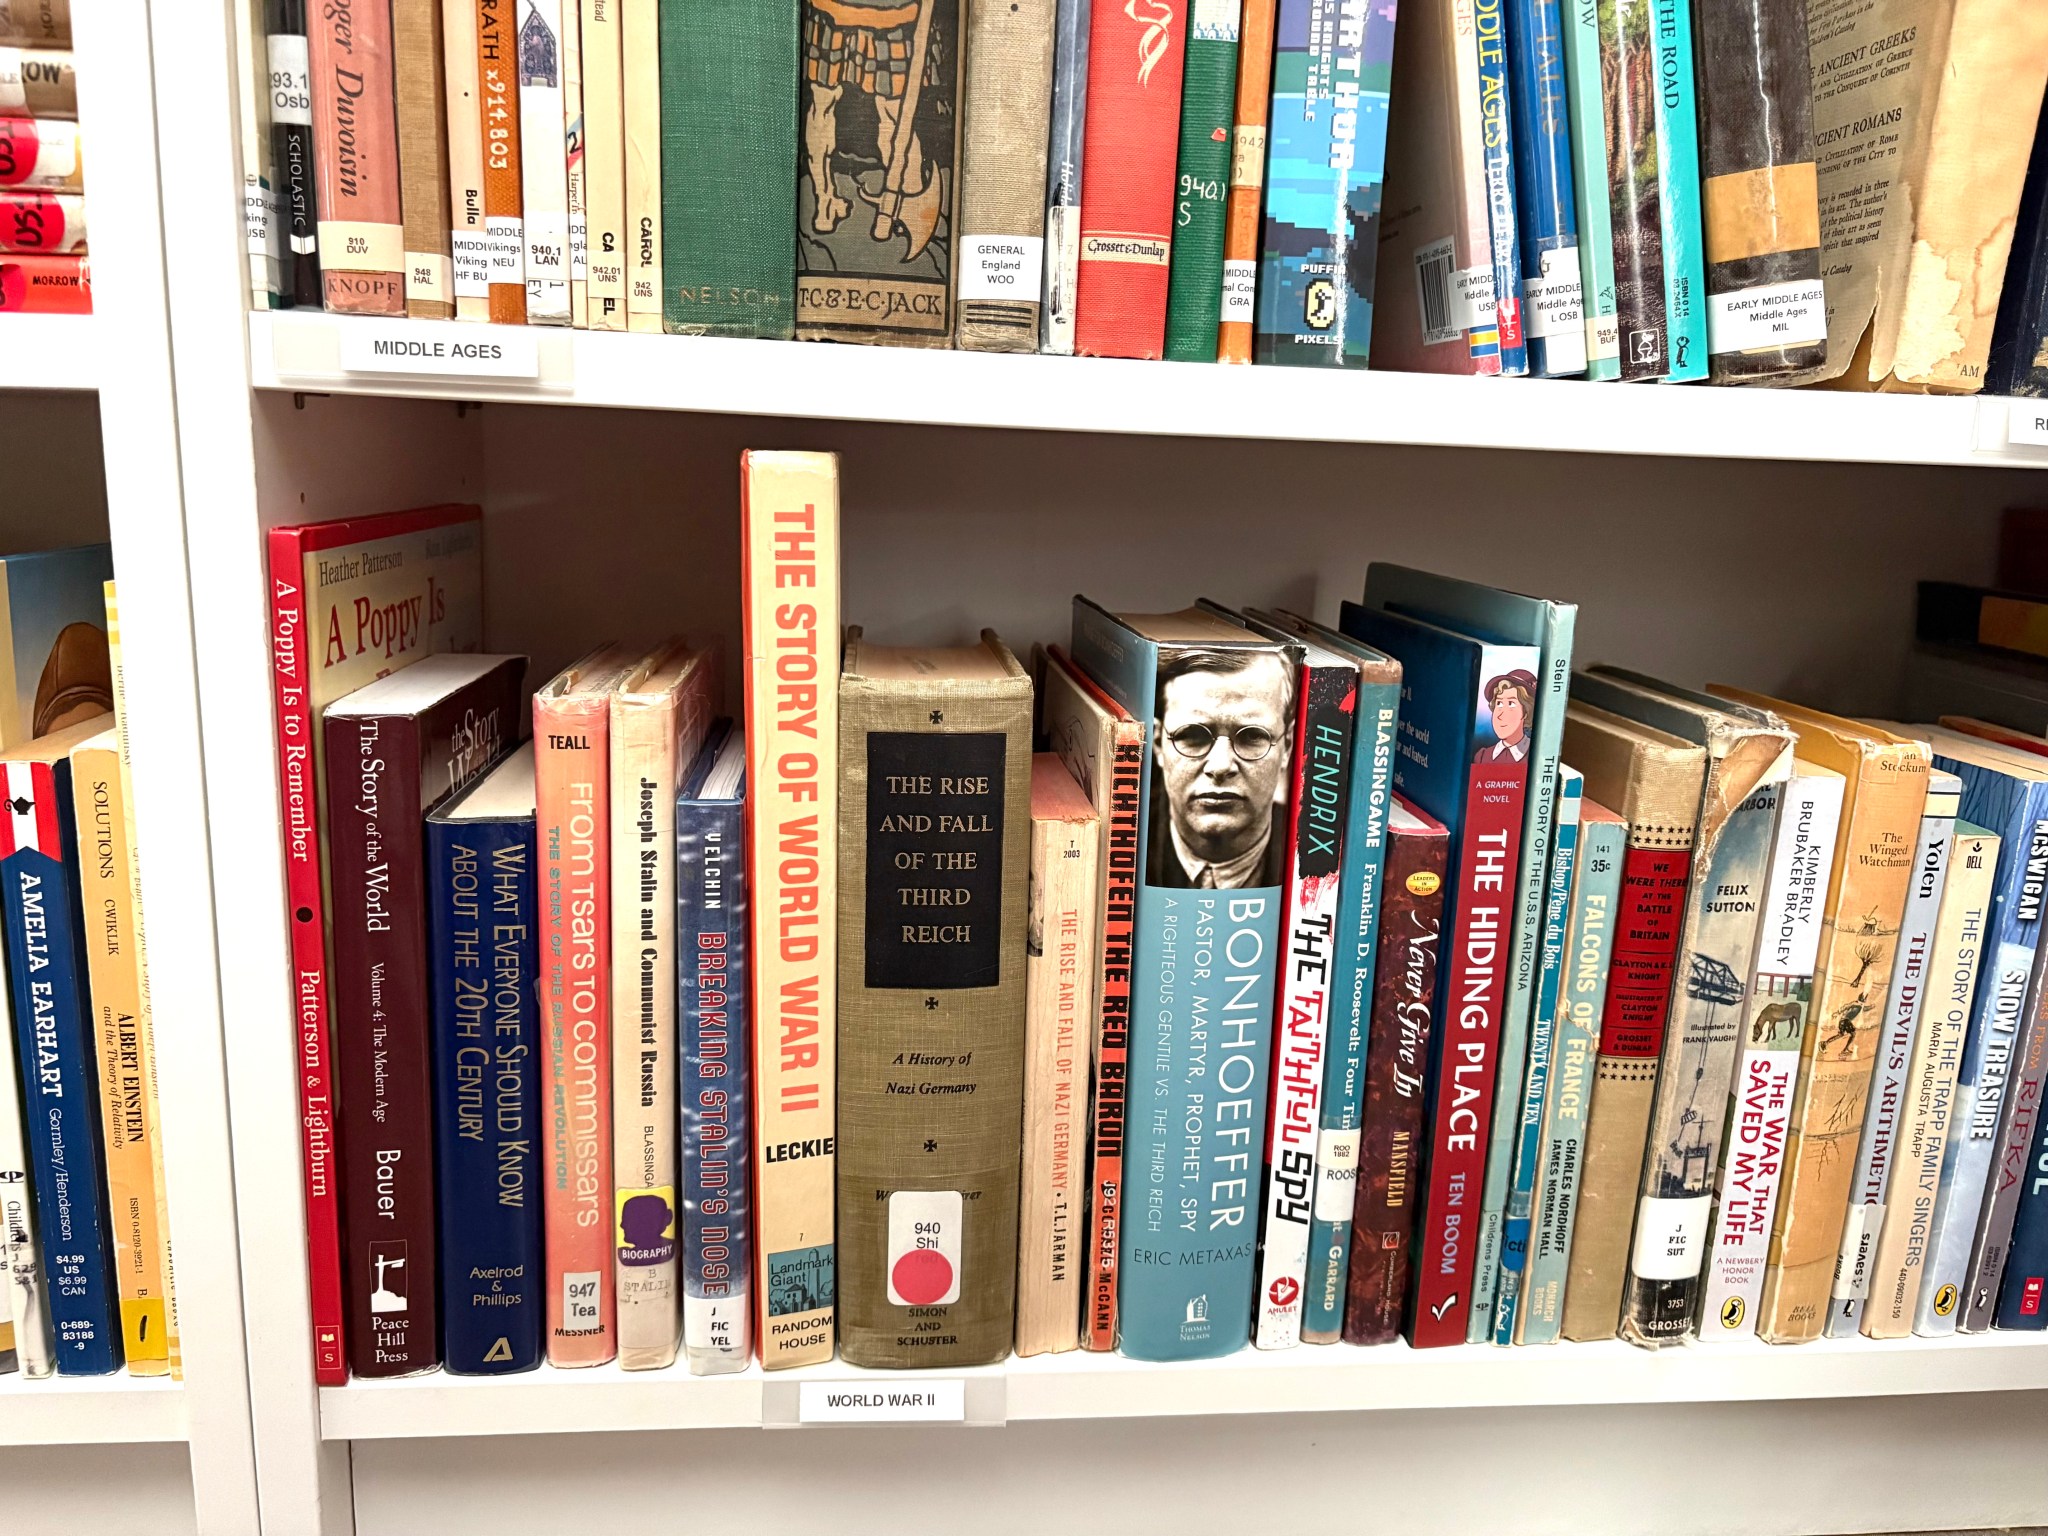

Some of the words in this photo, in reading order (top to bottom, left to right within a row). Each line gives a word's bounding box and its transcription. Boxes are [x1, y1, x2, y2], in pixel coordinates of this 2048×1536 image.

[1818, 48, 1865, 77] ANCIENT
[1869, 27, 1916, 56] GREEKS
[1662, 44, 1680, 110] ROAD
[275, 92, 310, 109] Osb
[335, 64, 367, 198] Duvoisin
[486, 69, 508, 170] x914.803
[288, 134, 306, 226] SCHOLASTIC
[465, 189, 478, 225] Bulla
[347, 245, 368, 254] DUV
[348, 237, 365, 246] 910
[531, 245, 562, 256] 940.1
[977, 245, 1025, 256] GENERAL
[414, 268, 431, 276] 948
[535, 255, 559, 266] LAN
[593, 266, 621, 275] 942.01
[598, 274, 618, 283] UNS
[981, 260, 1021, 271] England
[328, 278, 398, 300] KNOPF
[413, 276, 433, 285] HAL
[633, 288, 653, 298] UNS
[635, 281, 651, 290] 942
[987, 275, 1014, 285] WOO
[1727, 299, 1758, 312] EARLY
[1762, 295, 1799, 307] MIDDLE
[1801, 290, 1823, 302] AGES
[1750, 309, 1786, 322] Middle
[1788, 306, 1808, 319] Ages
[1772, 322, 1789, 333] MIL
[373, 340, 445, 358] MIDDLE
[450, 342, 502, 360] AGES
[774, 503, 816, 589] THE
[319, 557, 360, 588] Heather
[362, 548, 403, 579] Patterson
[276, 580, 297, 599] A
[274, 608, 299, 679] Poppy
[775, 603, 818, 740] STORY
[1553, 658, 1566, 693] Stein
[282, 685, 302, 706] Is
[284, 709, 299, 736] to
[359, 720, 379, 754] The
[548, 735, 590, 750] TEALL
[355, 758, 385, 819] Story
[777, 752, 819, 803] OF
[886, 777, 933, 795] THE
[940, 777, 990, 795] RISE
[1307, 724, 1342, 856] HENDRIX
[1365, 708, 1394, 848] BLASSINGAME
[286, 742, 312, 862] Remember
[637, 777, 657, 842] Joseph
[366, 822, 381, 838] of
[880, 814, 932, 833] AND
[939, 814, 994, 833] FALL
[1882, 832, 1902, 843] The
[366, 839, 378, 862] the
[894, 852, 926, 870] OF
[932, 852, 978, 870] THE
[1474, 829, 1507, 892] THE
[1789, 801, 1814, 887] BRUBAKER
[1859, 855, 1910, 867] Watchman
[1870, 844, 1908, 856] Winged
[1966, 856, 1982, 868] DELL
[93, 781, 114, 878] SOLUTIONS
[105, 899, 119, 956] CWIKLIK
[452, 843, 478, 920] ABOUT
[492, 843, 526, 916] WHAT
[641, 850, 657, 903] Stalin
[705, 833, 721, 910] YELCHIN
[1797, 845, 1821, 924] KIMBERLY
[1919, 838, 1944, 899] Yolen
[365, 863, 390, 932] World
[778, 814, 819, 963] WORLD
[897, 888, 971, 906] THIRD
[1717, 884, 1749, 896] FELIX
[20, 871, 49, 973] AMELIA
[641, 908, 657, 941] and
[1706, 901, 1755, 914] SUTTON
[902, 925, 971, 943] REICH
[1190, 899, 1215, 986] PASTOR,
[1575, 895, 1607, 993] FALCONS
[1776, 892, 1799, 966] BRADLEY
[454, 931, 479, 968] THE
[1904, 933, 1927, 979] THE
[493, 924, 527, 1037] EVERYONE
[1459, 906, 1500, 1031] HIDING
[455, 978, 489, 1038] 20TH
[641, 948, 657, 1045] Communist
[697, 932, 728, 1078] BREAKING
[1992, 967, 2026, 1033] SNOW
[301, 970, 321, 1069] Patterson
[780, 975, 819, 1072] WAR
[1889, 985, 1917, 1070] DEVIL'S
[32, 981, 62, 1097] EARHART
[118, 1012, 140, 1067] ALBERT
[1185, 995, 1210, 1084] MARTYR,
[306, 1074, 321, 1088] &
[641, 1050, 657, 1107] Russia
[1209, 897, 1266, 1232] BONHOEFFER
[1558, 1038, 1588, 1121] FRANCE
[121, 1067, 144, 1144] EINSTEIN
[456, 1046, 490, 1142] CENTURY
[495, 1045, 529, 1133] SHOULD
[781, 1083, 819, 1113] II
[1448, 1042, 1485, 1153] PLACE
[1740, 1060, 1771, 1144] SAVED
[1768, 1072, 1789, 1109] THE
[1970, 1037, 2013, 1140] TREASURE
[304, 1095, 331, 1198] Lightburn
[766, 1137, 834, 1163] LECKIE
[1179, 1093, 1204, 1188] PROPHET,
[1757, 1117, 1786, 1178] WAR
[2000, 1077, 2038, 1192] RIFKA
[49, 1108, 72, 1242] Gormley/Henderson
[497, 1140, 530, 1208] KNOW
[1387, 1131, 1410, 1207] MANSFIELD
[1564, 1138, 1577, 1190] CHARLES
[1733, 1152, 1756, 1192] MY
[375, 1149, 401, 1220] Bauer
[1448, 1171, 1465, 1206] TEN
[1180, 1198, 1198, 1232] SPY
[1554, 1191, 1570, 1254] NORDHOFF
[1723, 1200, 1749, 1246] LIFE
[1749, 1186, 1770, 1235] THAT
[914, 1223, 941, 1235] 940
[916, 1238, 939, 1249] Shi
[1440, 1214, 1462, 1275] BOOM
[1669, 1236, 1686, 1245] FIC
[56, 1256, 85, 1266] $4.99
[622, 1244, 672, 1260] BIOGRAPHY
[701, 1226, 730, 1296] NOSE
[770, 1254, 834, 1276] Landmark
[1134, 1249, 1171, 1266] ERIC
[1179, 1243, 1251, 1265] METAXAS
[1667, 1248, 1685, 1257] SUT
[58, 1276, 87, 1287] $6.99
[64, 1266, 79, 1276] US
[470, 1264, 524, 1279] Axelrod
[491, 1280, 503, 1292] &
[770, 1271, 807, 1288] Giant
[1324, 1245, 1343, 1311] GARRARD
[62, 1286, 86, 1297] CAN
[472, 1293, 522, 1308] Phillips
[569, 1282, 597, 1297] 947
[372, 1317, 409, 1331] Peace
[571, 1302, 597, 1317] Tea
[711, 1321, 729, 1331] FIC
[772, 1314, 833, 1335] RANDOM
[375, 1349, 409, 1363] Press
[377, 1332, 405, 1347] Hill
[711, 1336, 730, 1346] YEL
[779, 1333, 826, 1350] HOUSE
[827, 1394, 884, 1408] WORLD
[888, 1394, 923, 1407] WAR
[927, 1394, 935, 1406] II
